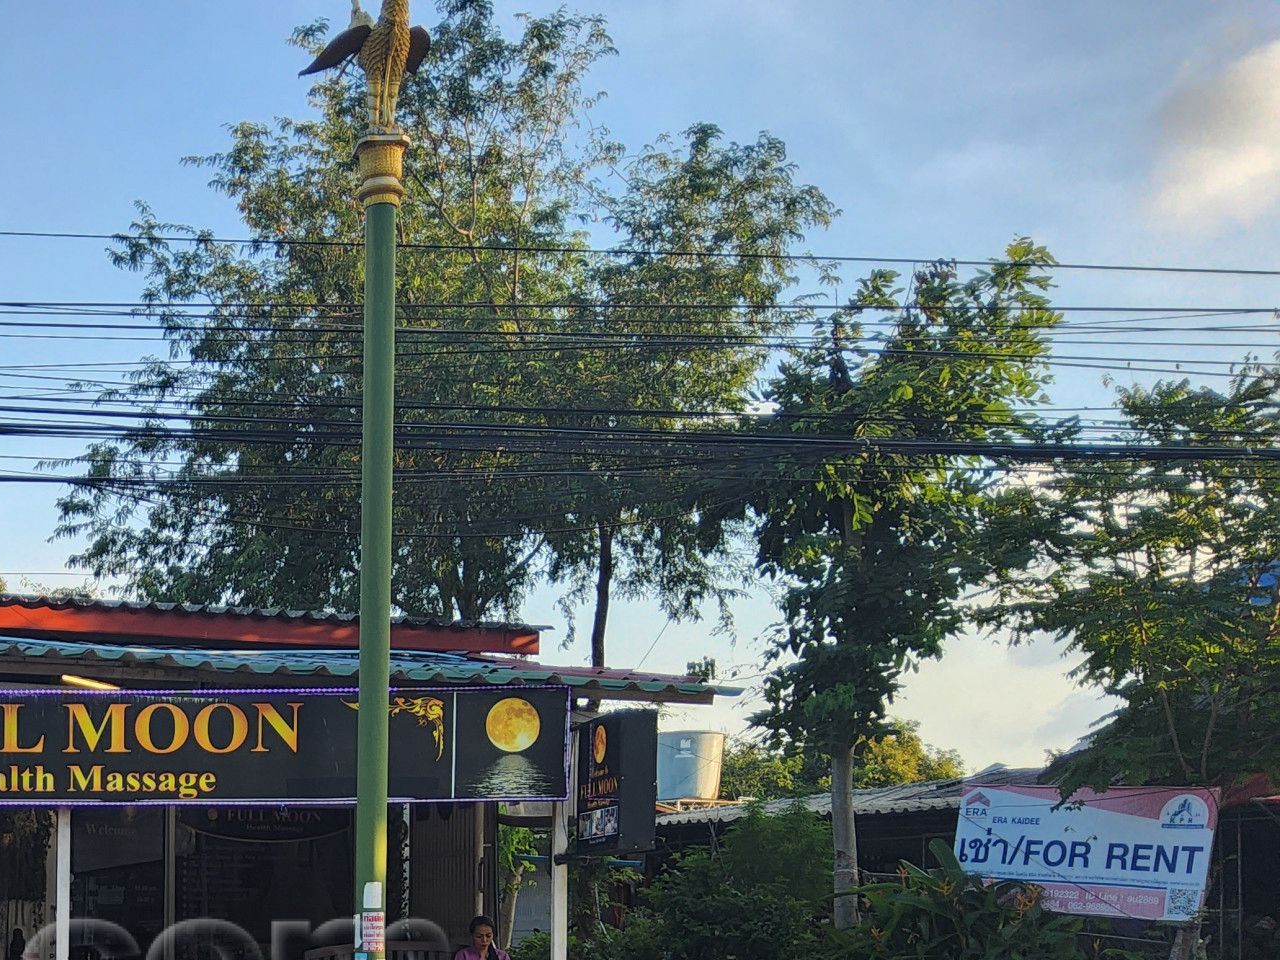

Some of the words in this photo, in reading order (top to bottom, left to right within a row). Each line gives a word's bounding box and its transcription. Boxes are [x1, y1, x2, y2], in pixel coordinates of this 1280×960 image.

[62, 702, 304, 755] MOON
[68, 765, 217, 799] Massage
[965, 807, 988, 817] ERA
[992, 816, 1008, 825] ERA
[1011, 817, 1041, 826] KAIDEE
[1104, 842, 1204, 875] RENT
